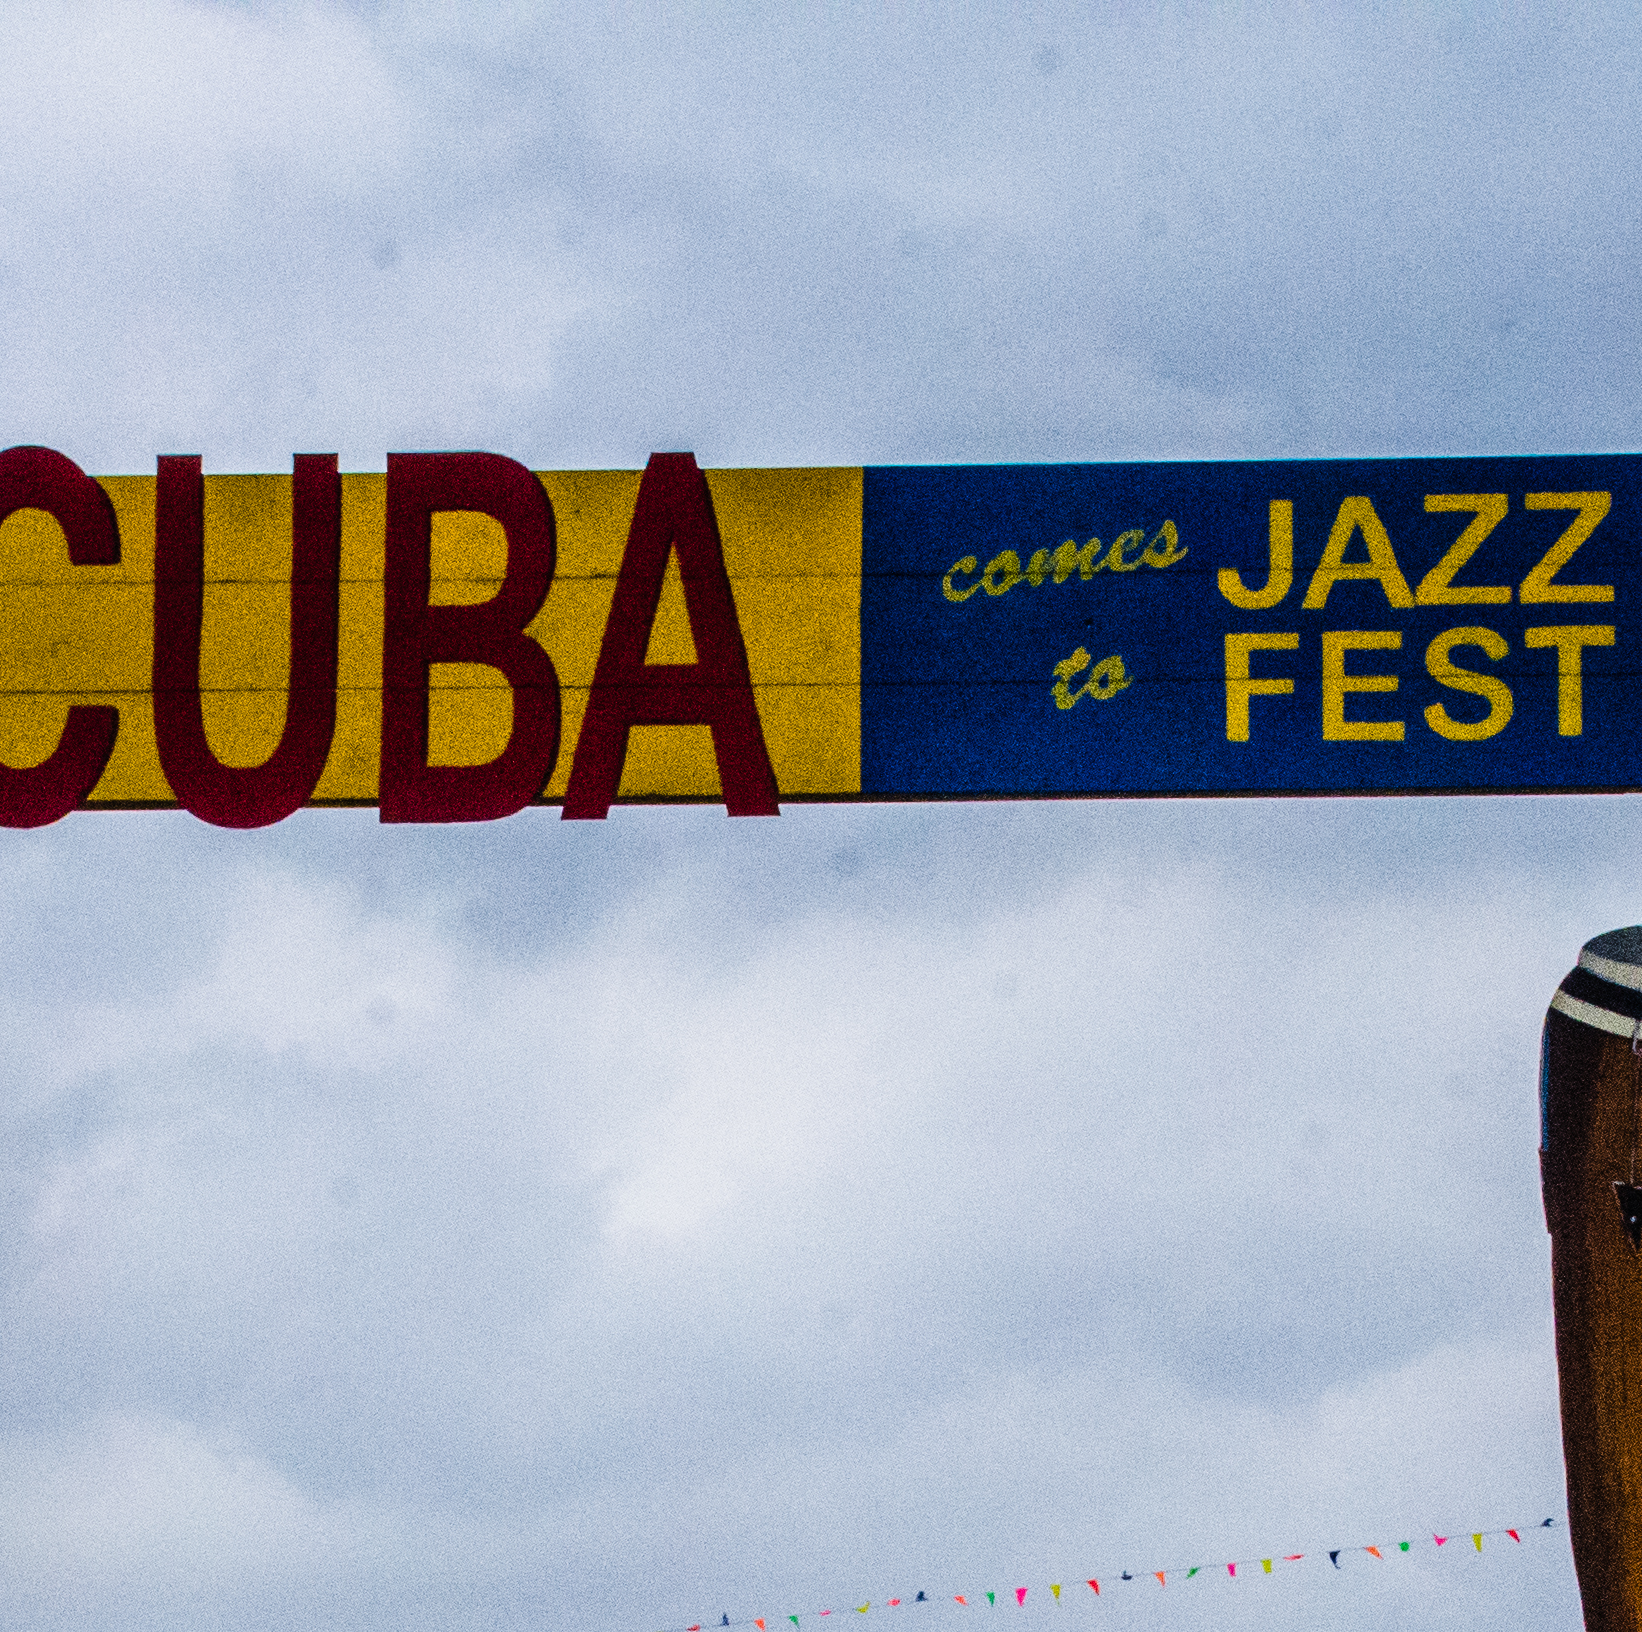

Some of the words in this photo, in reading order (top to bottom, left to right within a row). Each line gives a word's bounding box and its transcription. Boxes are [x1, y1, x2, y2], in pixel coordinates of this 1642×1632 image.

[942, 519, 1189, 603] comes
[1217, 491, 1616, 610] JAZZ
[1050, 646, 1134, 710] to
[1223, 625, 1617, 742] FEST
